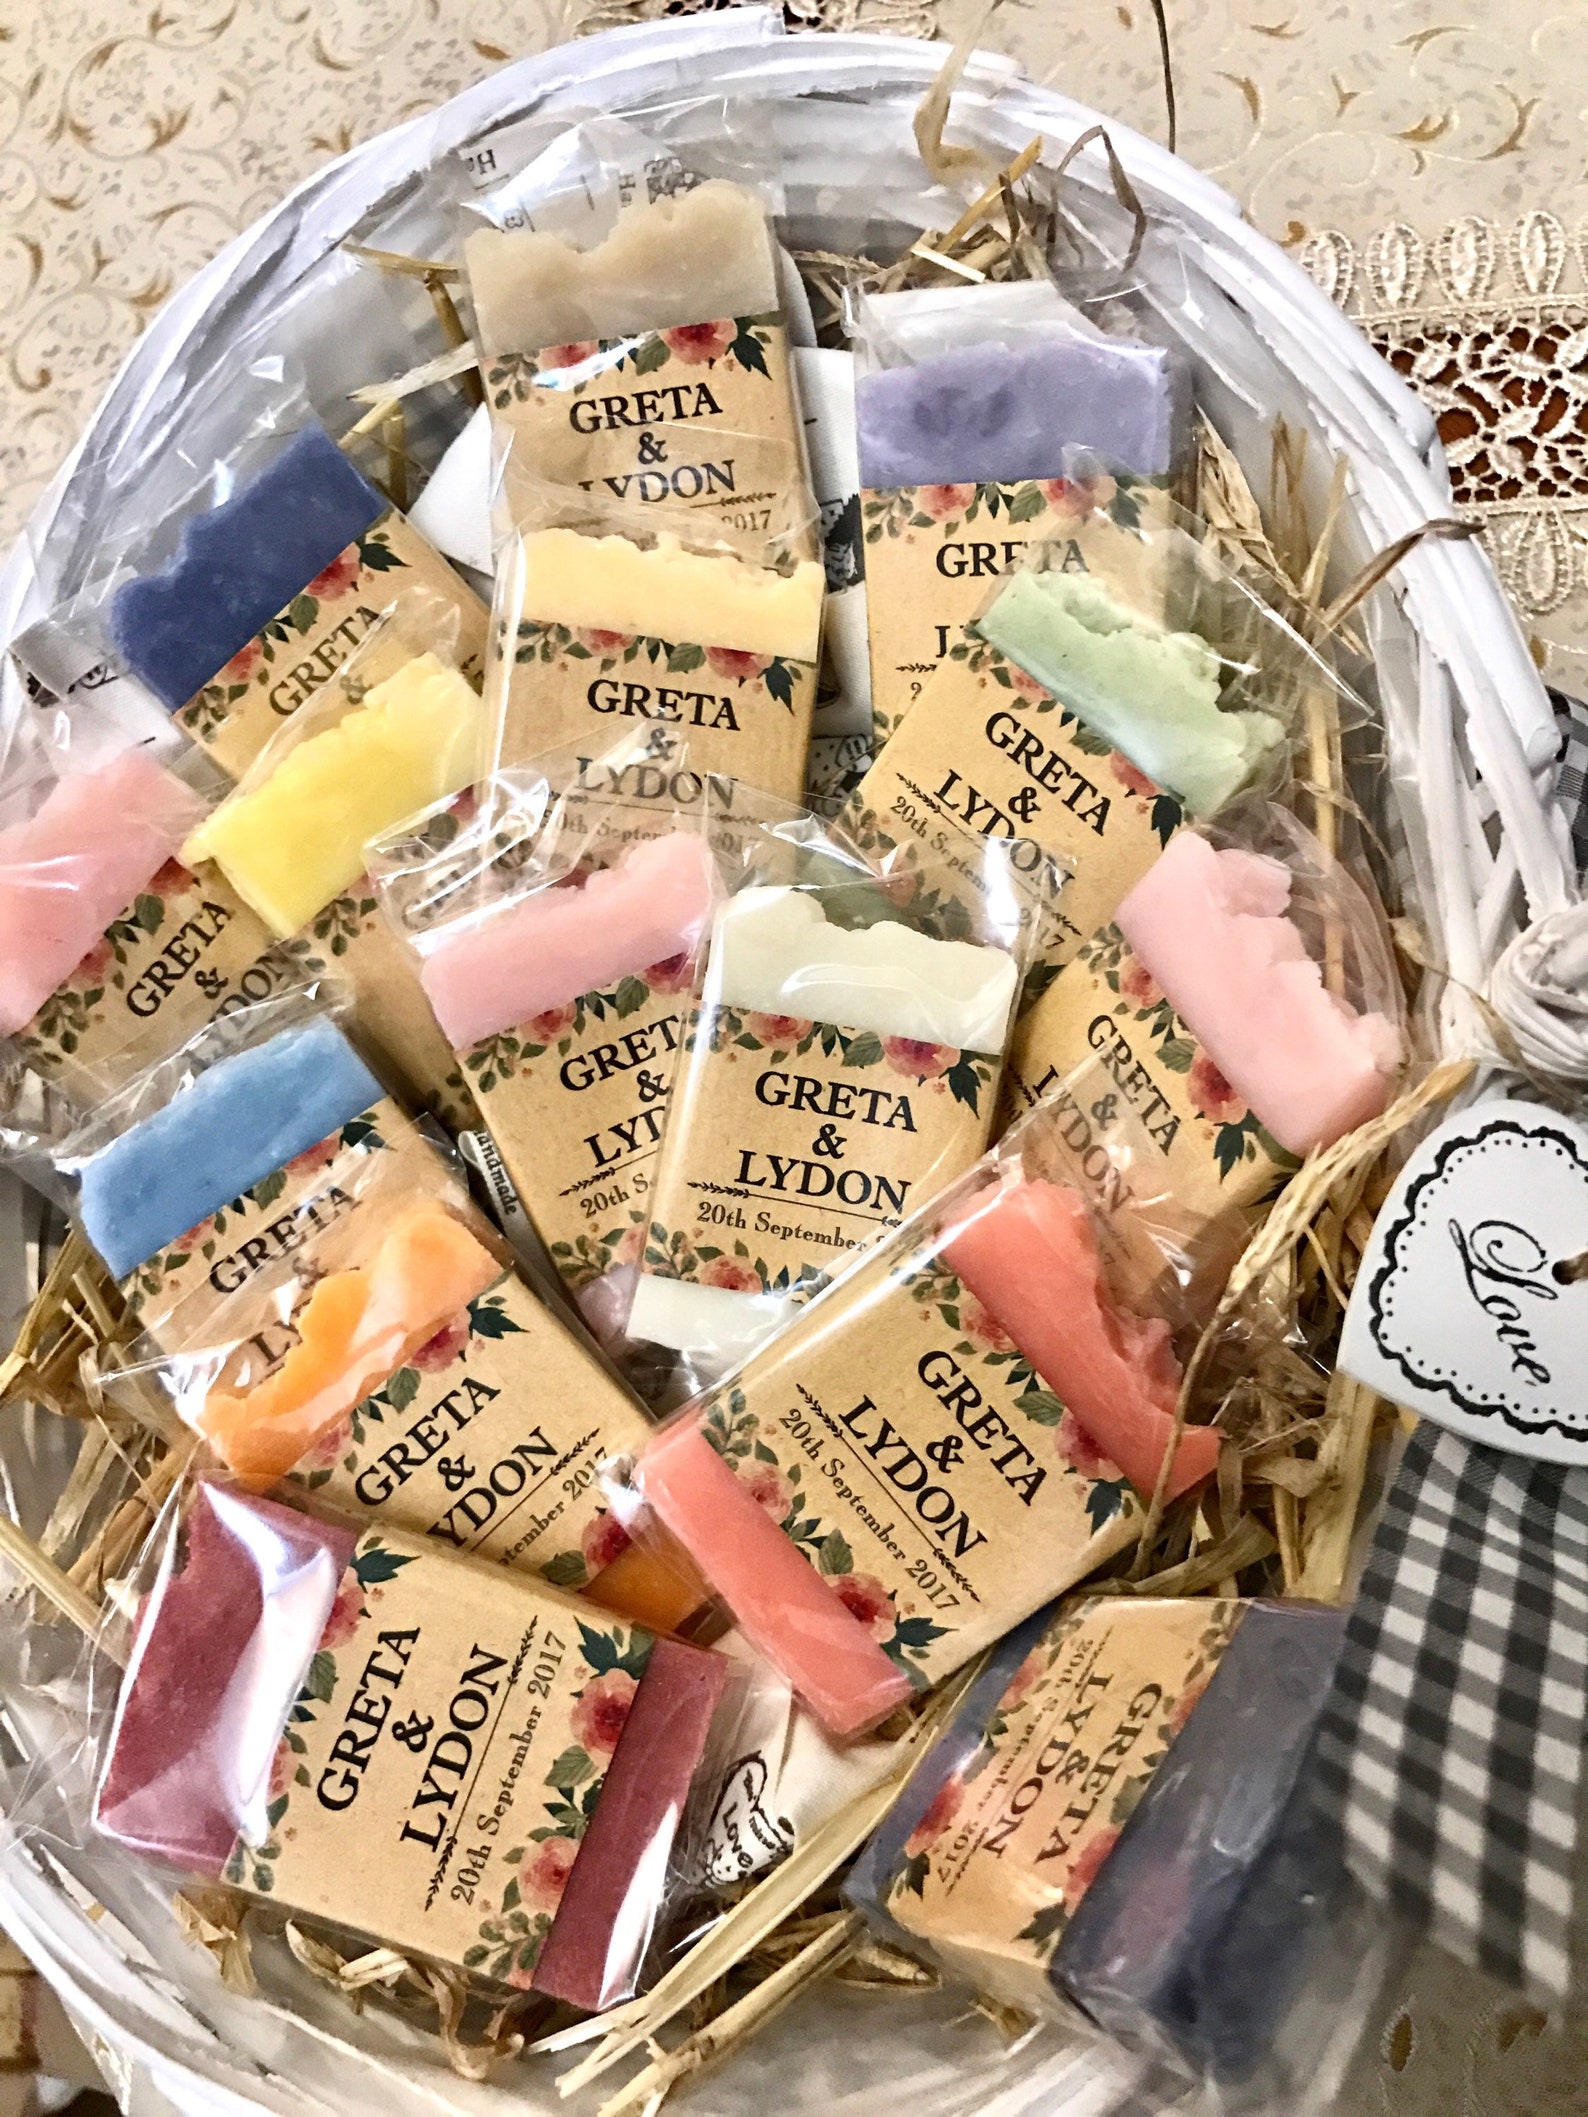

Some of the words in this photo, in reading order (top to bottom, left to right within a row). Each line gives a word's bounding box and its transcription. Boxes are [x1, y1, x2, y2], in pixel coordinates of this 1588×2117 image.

[569, 381, 723, 434] GRETA
[637, 431, 668, 464] &
[578, 459, 735, 503] YDON
[936, 539, 1090, 578] GRETA
[269, 604, 383, 717] GRETA
[339, 672, 374, 704] &
[587, 678, 741, 731] GRETA
[646, 727, 678, 761] &
[985, 711, 1115, 836] GRETA
[574, 756, 739, 810] LYDON
[1008, 786, 1042, 823] &
[890, 795, 929, 839] 20th
[933, 769, 1076, 900] LYDON
[126, 899, 234, 1019] GRETA
[195, 967, 228, 999] &
[559, 1014, 681, 1093] GRET
[1087, 1013, 1181, 1157] GRETA
[636, 1069, 669, 1103] &
[755, 1069, 918, 1133] GRETA
[1091, 1094, 1118, 1131] &
[812, 1123, 846, 1159] &
[579, 1189, 631, 1220] 20th
[733, 1149, 912, 1215] LYDON
[209, 1185, 363, 1294] GRETA
[696, 1201, 748, 1230] 20th
[753, 1217, 867, 1254] September
[1449, 1218, 1559, 1387] Love
[354, 1375, 502, 1507] GRETA
[917, 1350, 1048, 1507] GRETA
[925, 1434, 966, 1474] &
[427, 1425, 559, 1548] YDON
[437, 1454, 476, 1492] &
[838, 1394, 989, 1559] LYDON
[778, 1407, 827, 1461] 20th
[820, 1457, 906, 1562] September
[904, 1558, 961, 1612] 2017
[316, 1626, 421, 1812] GRETA
[391, 1711, 436, 1753] &
[399, 1643, 509, 1853] LYDON
[450, 1845, 494, 1906] 20th
[475, 1705, 543, 1838] September
[527, 1630, 569, 1700] 2017
[982, 1671, 1115, 1859] LYDON
[1033, 1682, 1163, 1866] GRETA
[1055, 1749, 1090, 1785] &
[937, 1819, 979, 1884] 2017
